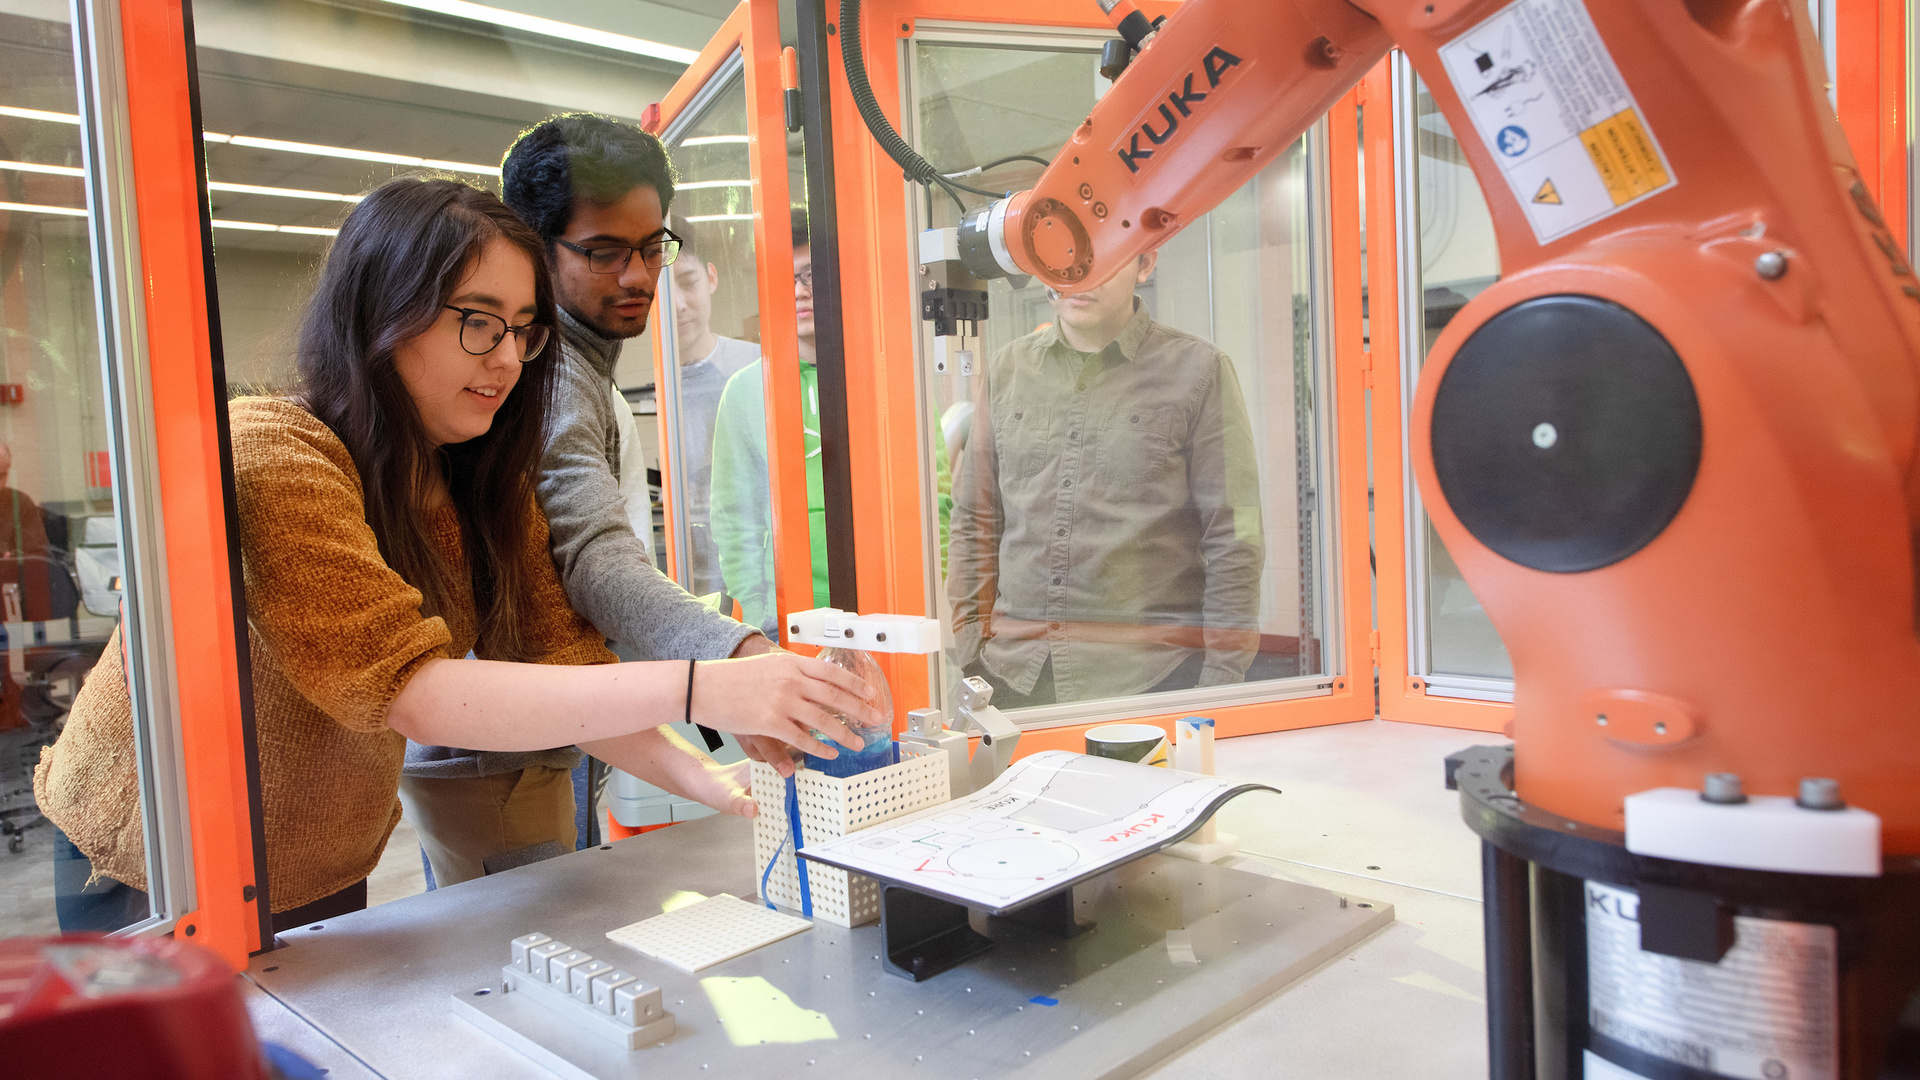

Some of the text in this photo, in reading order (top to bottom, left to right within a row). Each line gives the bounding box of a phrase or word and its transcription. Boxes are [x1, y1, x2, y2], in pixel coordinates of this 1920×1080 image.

[1117, 46, 1243, 174] KUKA
[1099, 814, 1165, 842] KUKA
[1589, 888, 1638, 921] KU
